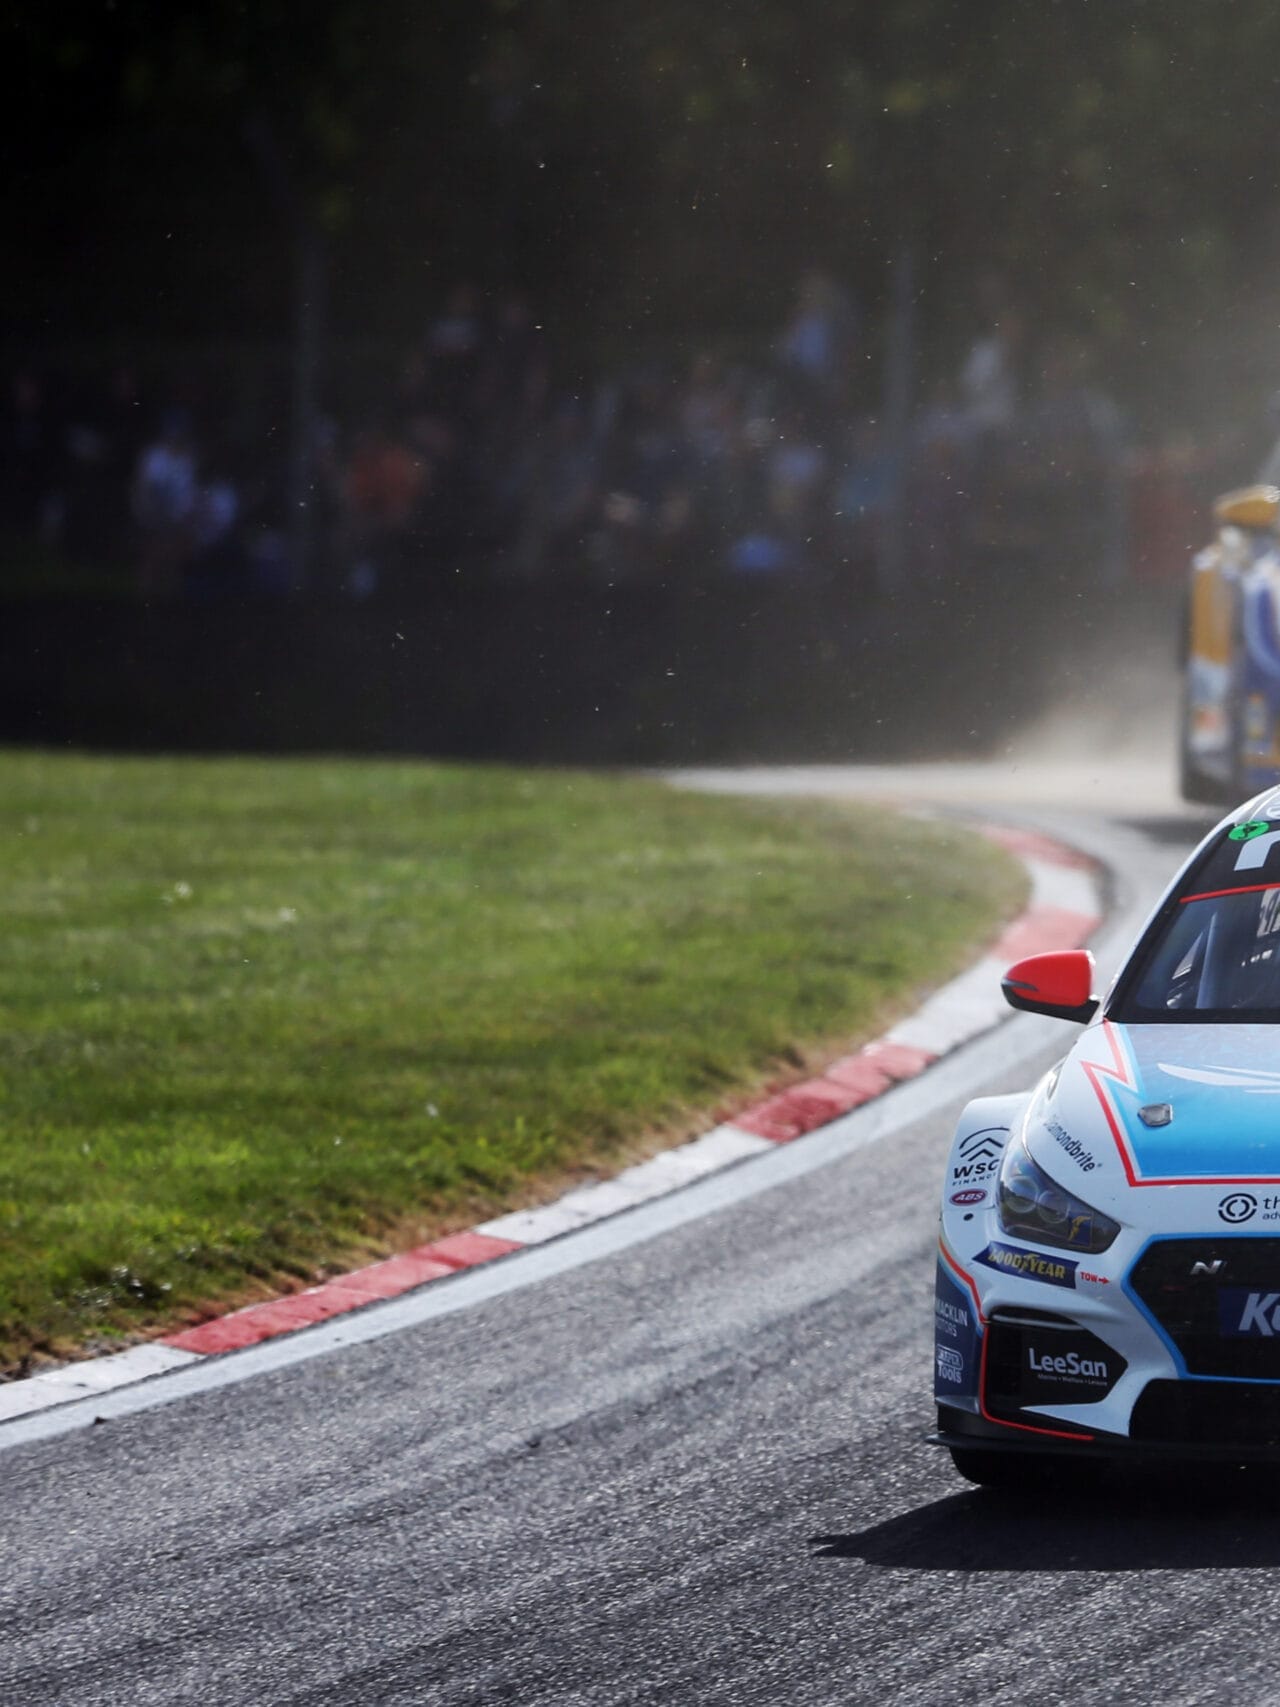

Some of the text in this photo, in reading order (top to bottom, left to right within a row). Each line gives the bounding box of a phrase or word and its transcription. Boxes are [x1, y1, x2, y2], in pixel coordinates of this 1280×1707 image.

[953, 1159, 1000, 1179] WSC
[954, 1191, 985, 1202] ABS
[1079, 1271, 1098, 1284] TOW
[1028, 1347, 1108, 1378] LeeSan
